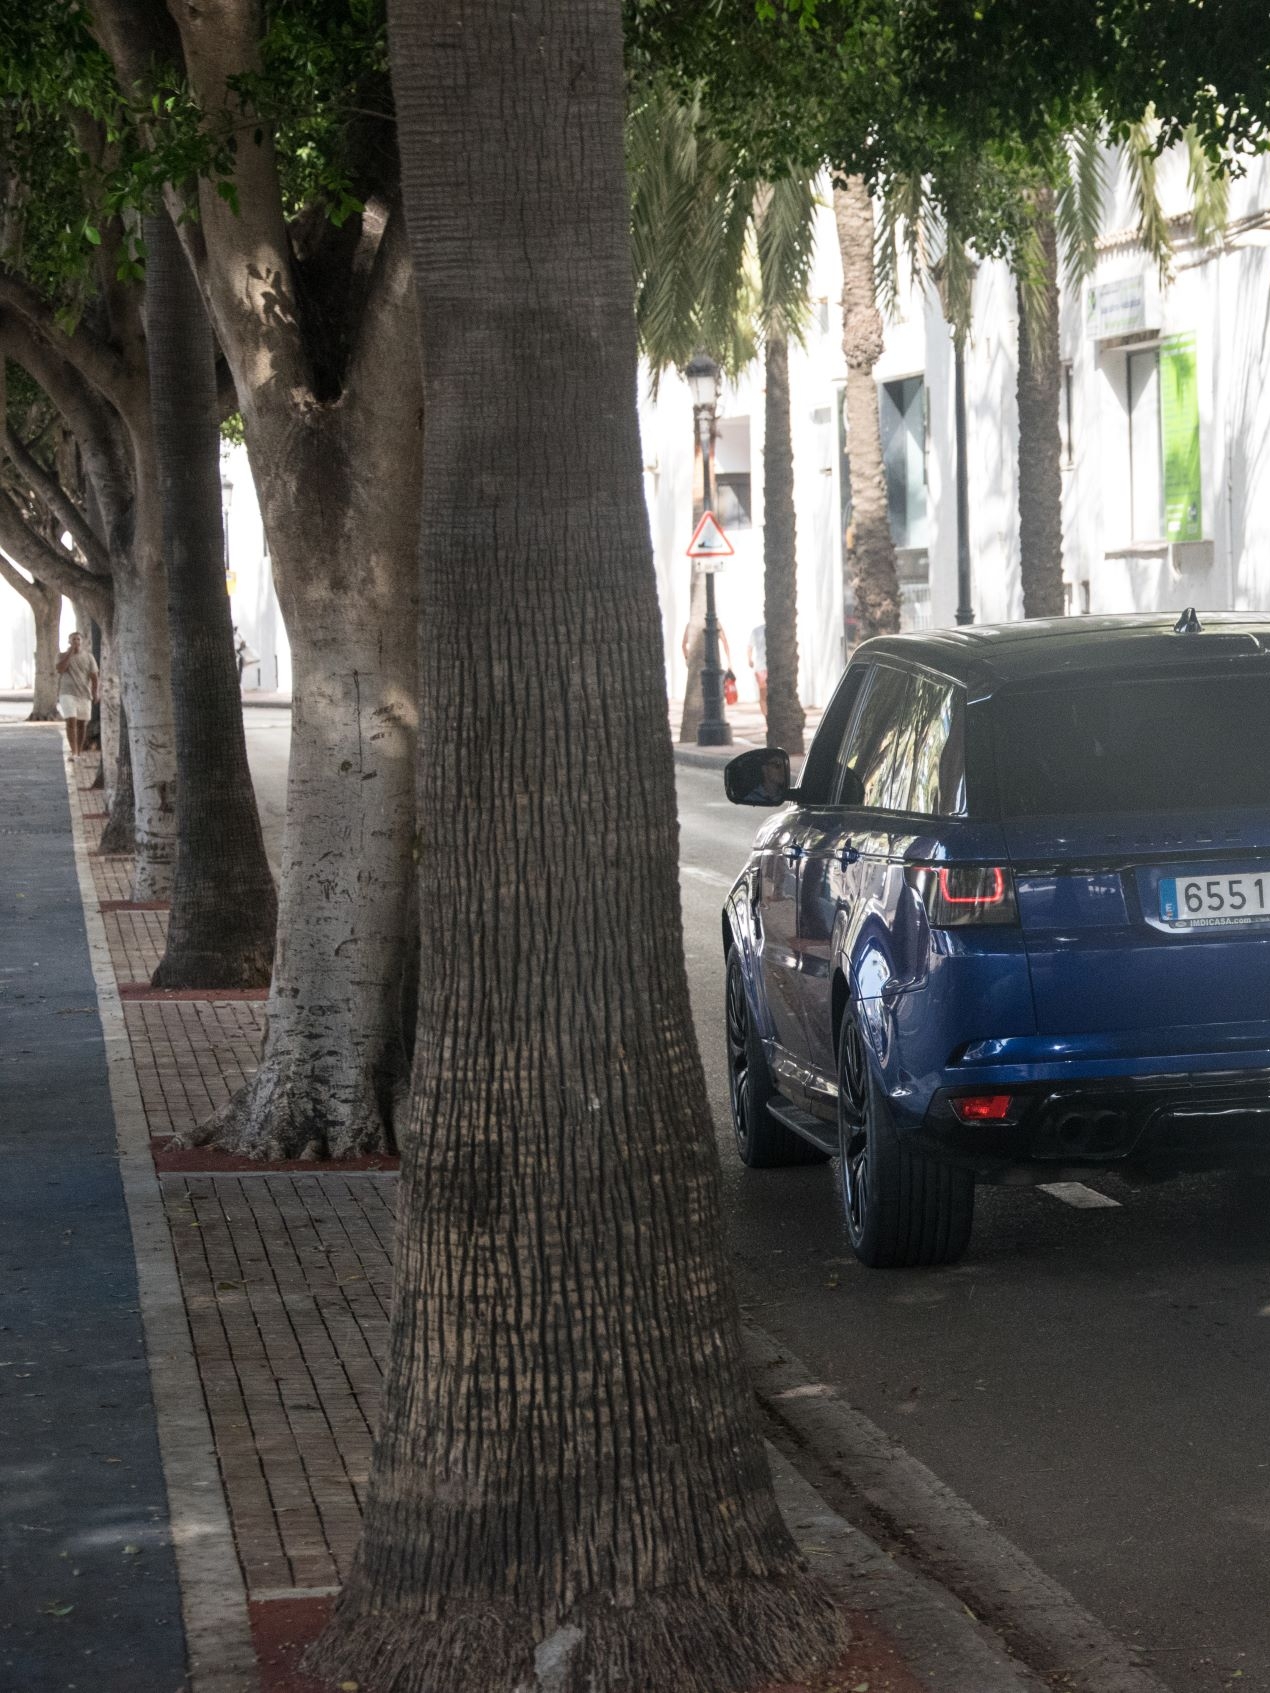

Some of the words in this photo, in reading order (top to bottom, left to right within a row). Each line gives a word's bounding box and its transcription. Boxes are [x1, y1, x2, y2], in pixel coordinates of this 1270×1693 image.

[1184, 878, 1265, 913] 6551
[1165, 903, 1173, 912] E
[1190, 917, 1252, 927] IMDICASA.com
